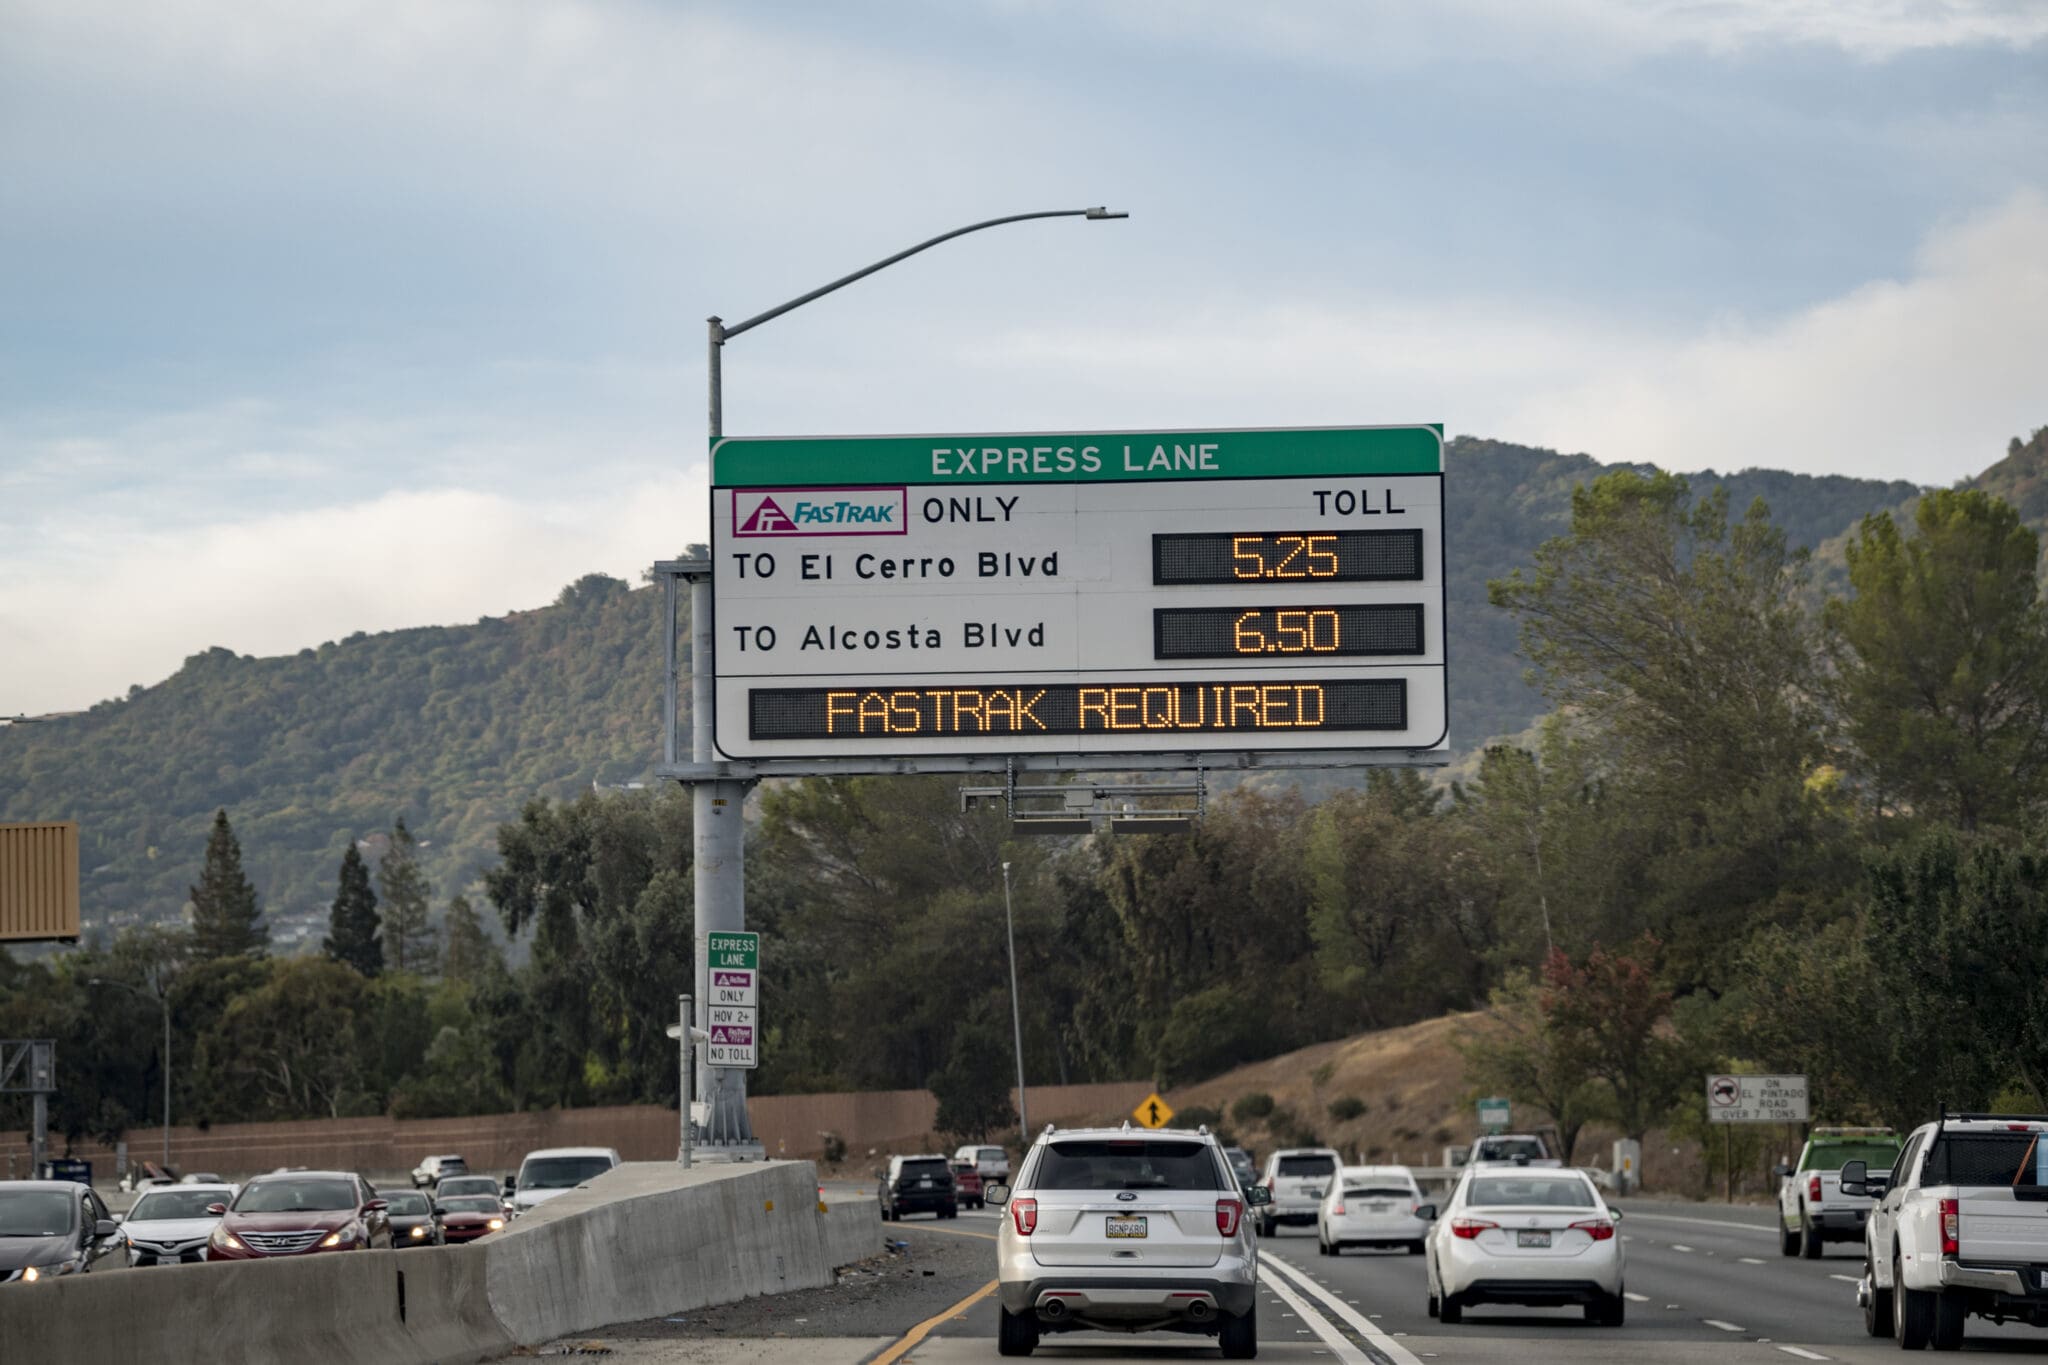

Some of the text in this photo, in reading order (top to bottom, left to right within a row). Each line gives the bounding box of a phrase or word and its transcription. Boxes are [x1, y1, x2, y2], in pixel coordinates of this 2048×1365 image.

[931, 444, 1220, 475] EXPRESS LANE
[923, 496, 1020, 523] ONLY
[1313, 489, 1406, 516] TOLL
[1233, 535, 1339, 578] 5.25
[732, 551, 1059, 580] TO El Cerro Blvd
[733, 622, 1045, 652] TO Alcosta Blvd
[1234, 610, 1340, 652] 6.50
[827, 685, 1324, 733] FASTRAK REQUIRED
[711, 938, 755, 952] EXPRESS
[720, 953, 745, 966] LANE
[720, 990, 745, 1002] ONLY
[714, 1010, 750, 1023] HOV 2+
[710, 1048, 752, 1061] NO TOLL
[1766, 1079, 1780, 1088] ON
[1742, 1089, 1804, 1098] EL PINTADO
[1760, 1099, 1788, 1108] ROAD
[1721, 1109, 1796, 1119] OVER 7 TONS
